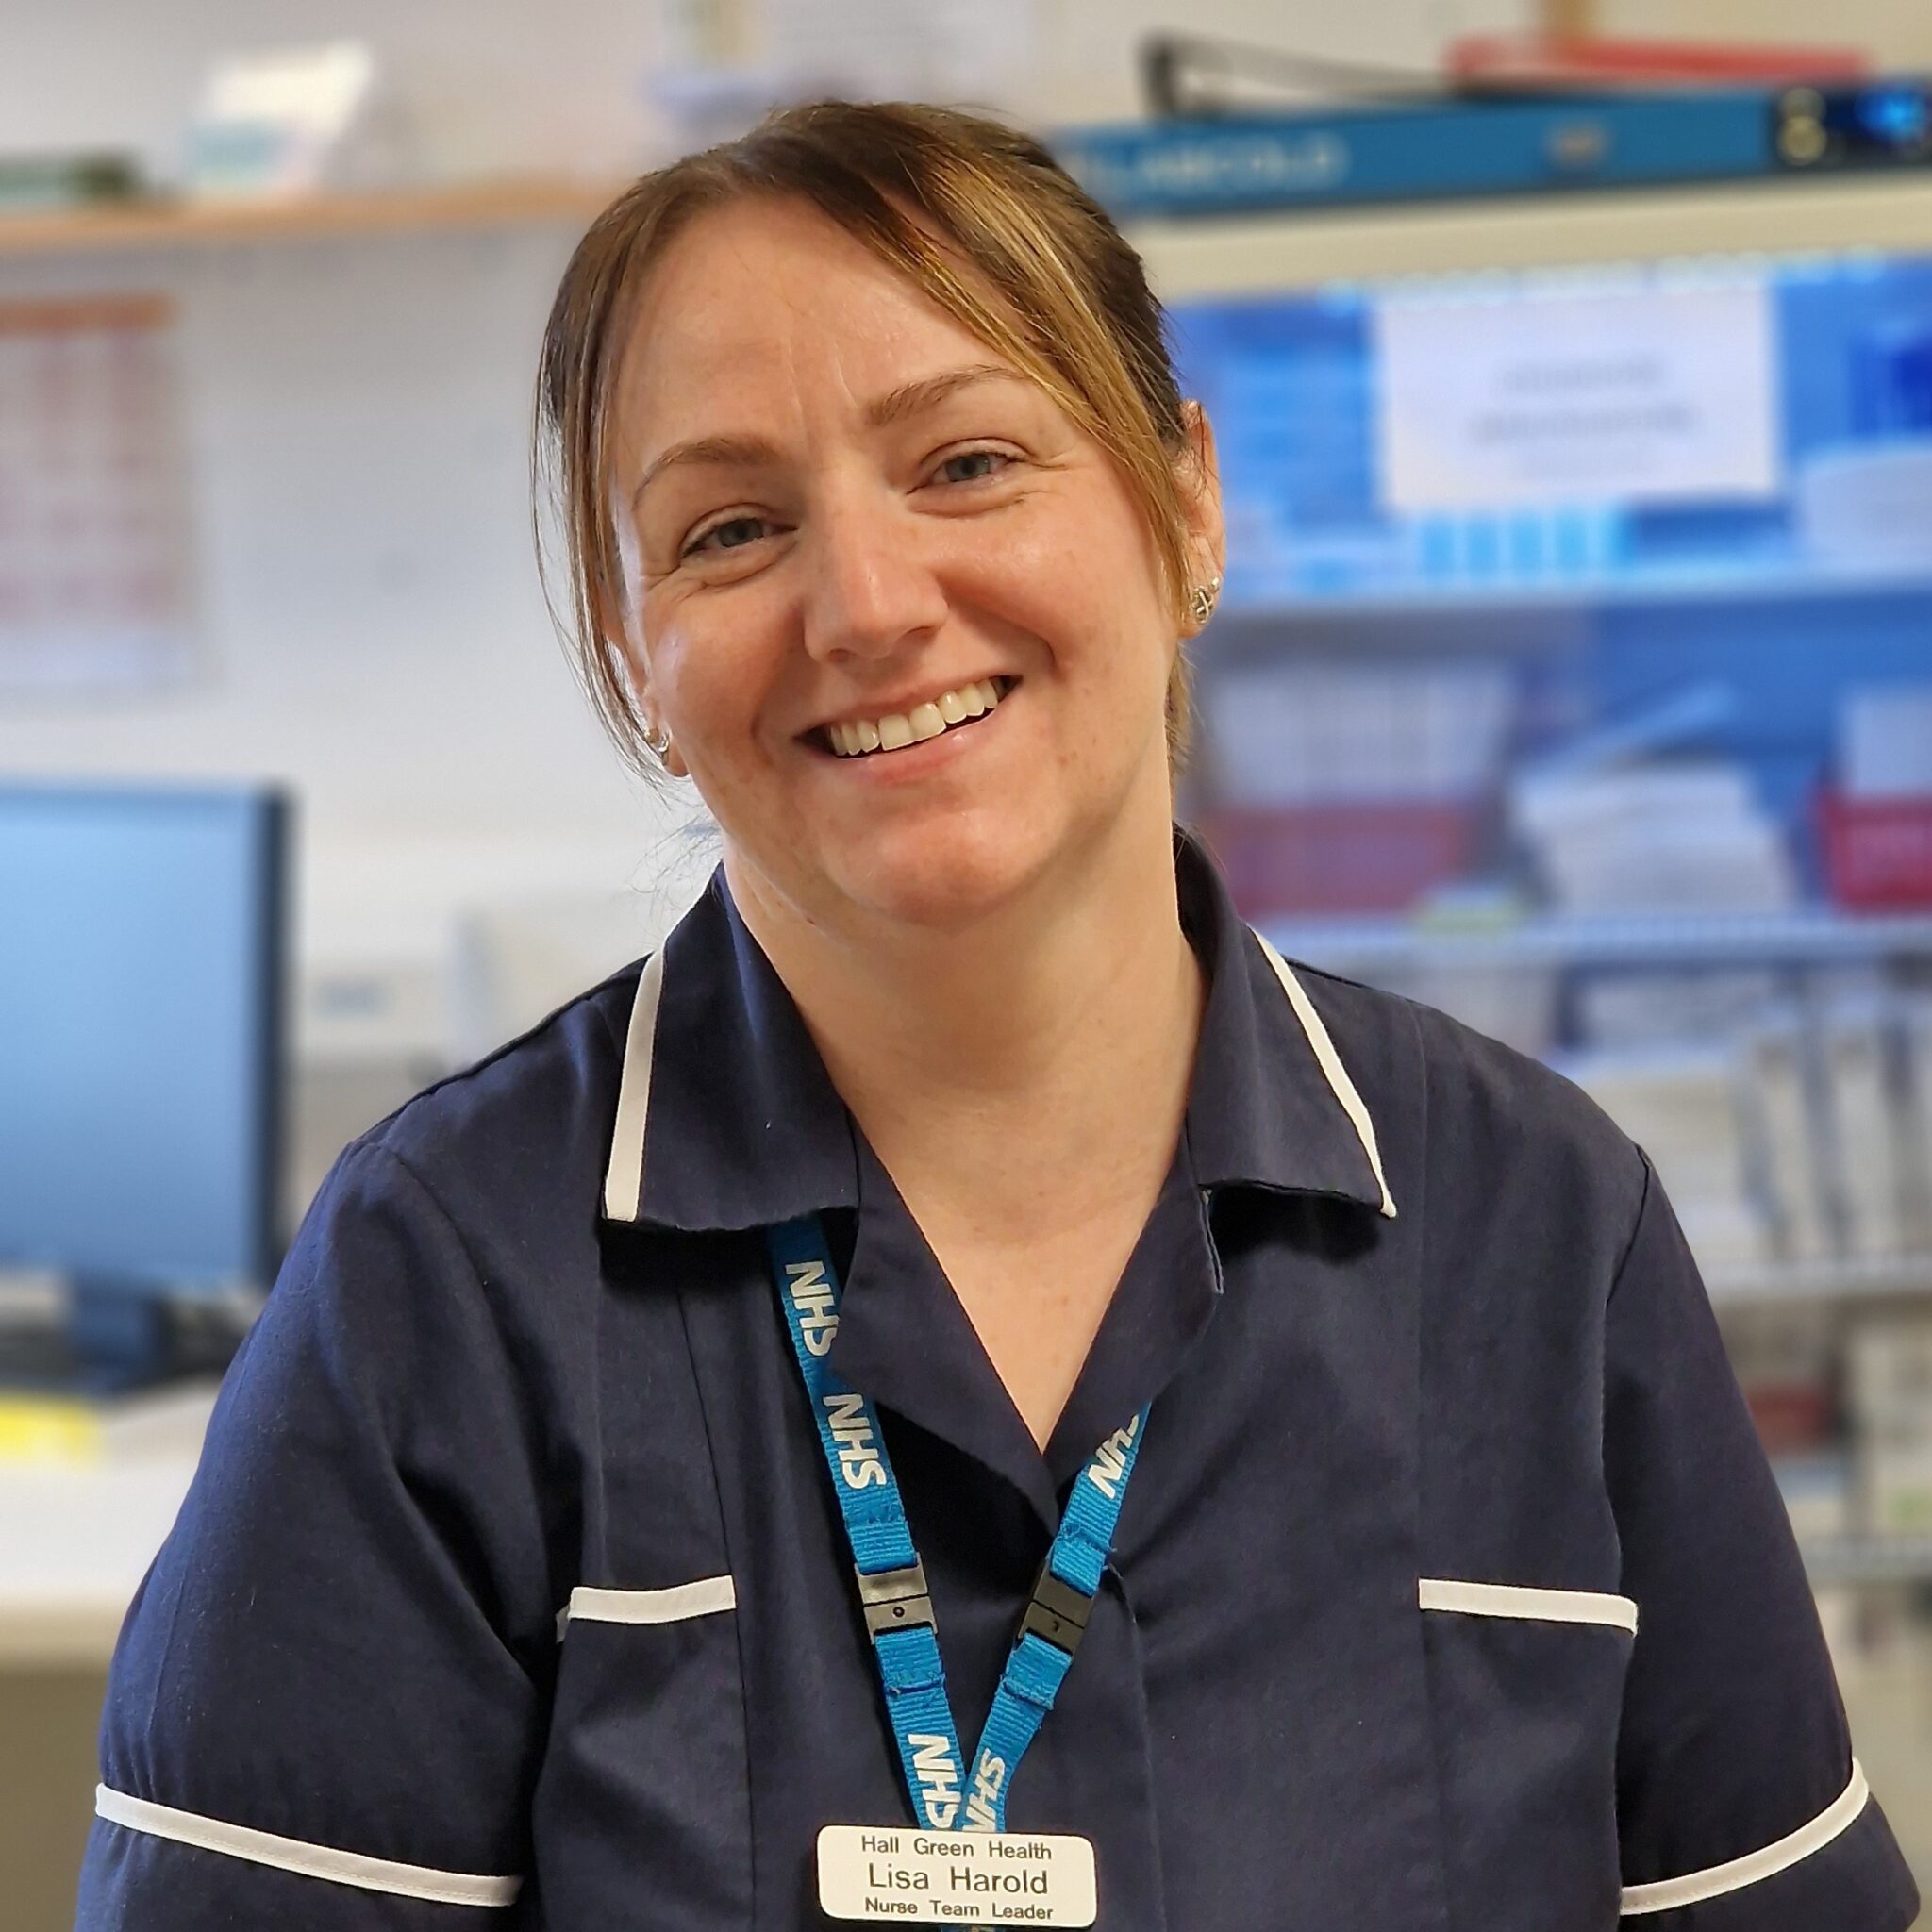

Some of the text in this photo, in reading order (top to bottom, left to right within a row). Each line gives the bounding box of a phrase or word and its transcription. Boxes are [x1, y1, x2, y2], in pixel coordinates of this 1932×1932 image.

[823, 1393, 887, 1490] NHS
[908, 1734, 962, 1829] NHS
[962, 1748, 1006, 1832] NHS
[861, 1835, 1052, 1860] Hall Green Health
[868, 1862, 1049, 1895] Lisa Harold
[864, 1897, 1054, 1920] Nurse Team Leader
